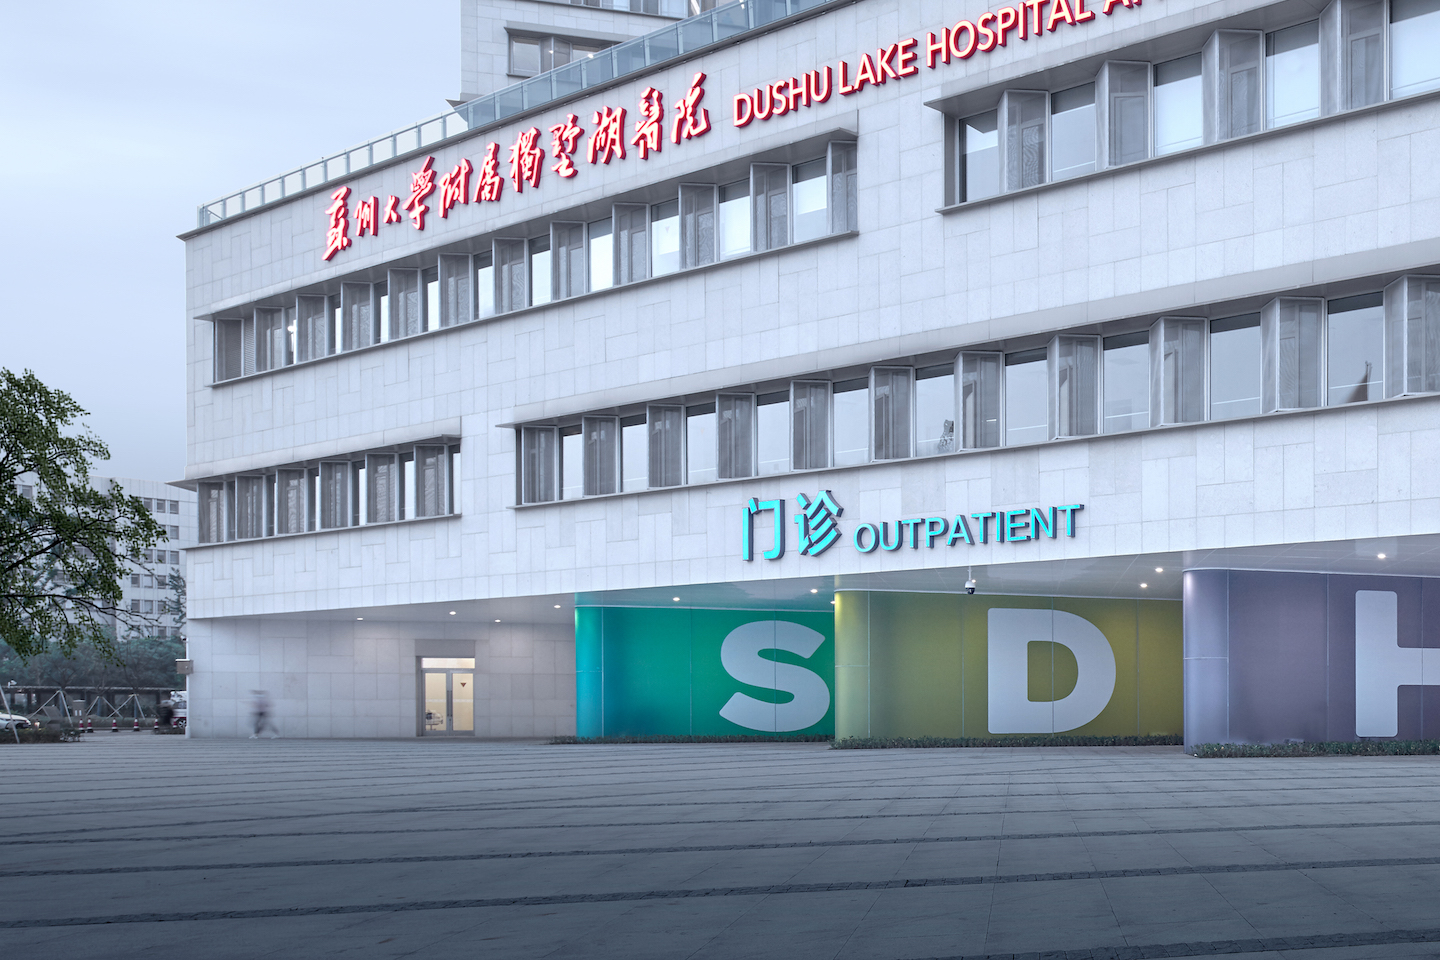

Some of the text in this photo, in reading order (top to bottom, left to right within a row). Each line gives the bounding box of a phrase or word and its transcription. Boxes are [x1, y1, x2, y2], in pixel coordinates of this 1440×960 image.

[733, 65, 833, 128] DUSHU
[837, 38, 919, 96] LAKE
[741, 490, 1085, 562] 门诊 OUTPATIENT
[719, 620, 830, 732] S
[987, 607, 1117, 734] D
